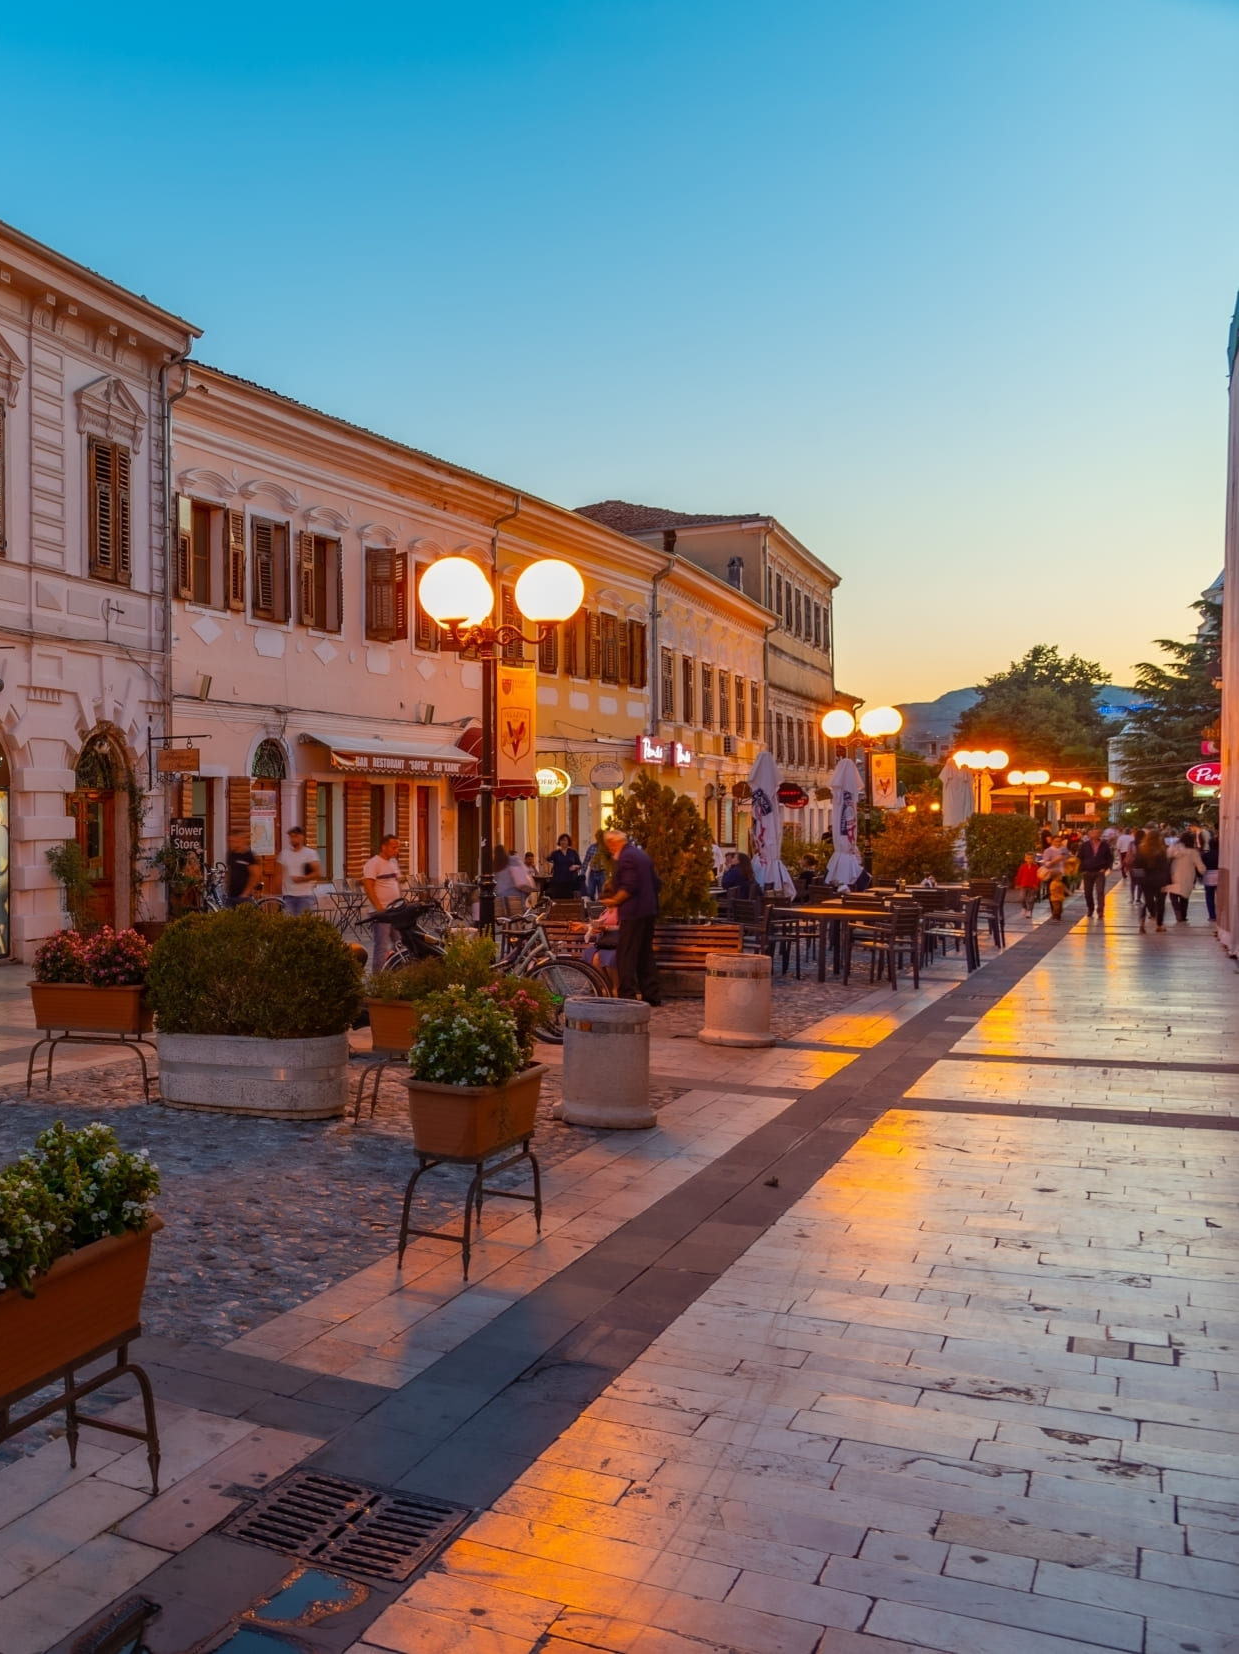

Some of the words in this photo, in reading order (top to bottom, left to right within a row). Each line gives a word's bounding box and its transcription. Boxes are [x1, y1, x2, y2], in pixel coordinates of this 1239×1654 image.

[372, 757, 405, 770] RESTORANT
[170, 824, 203, 836] Flower
[174, 839, 200, 850] Store
